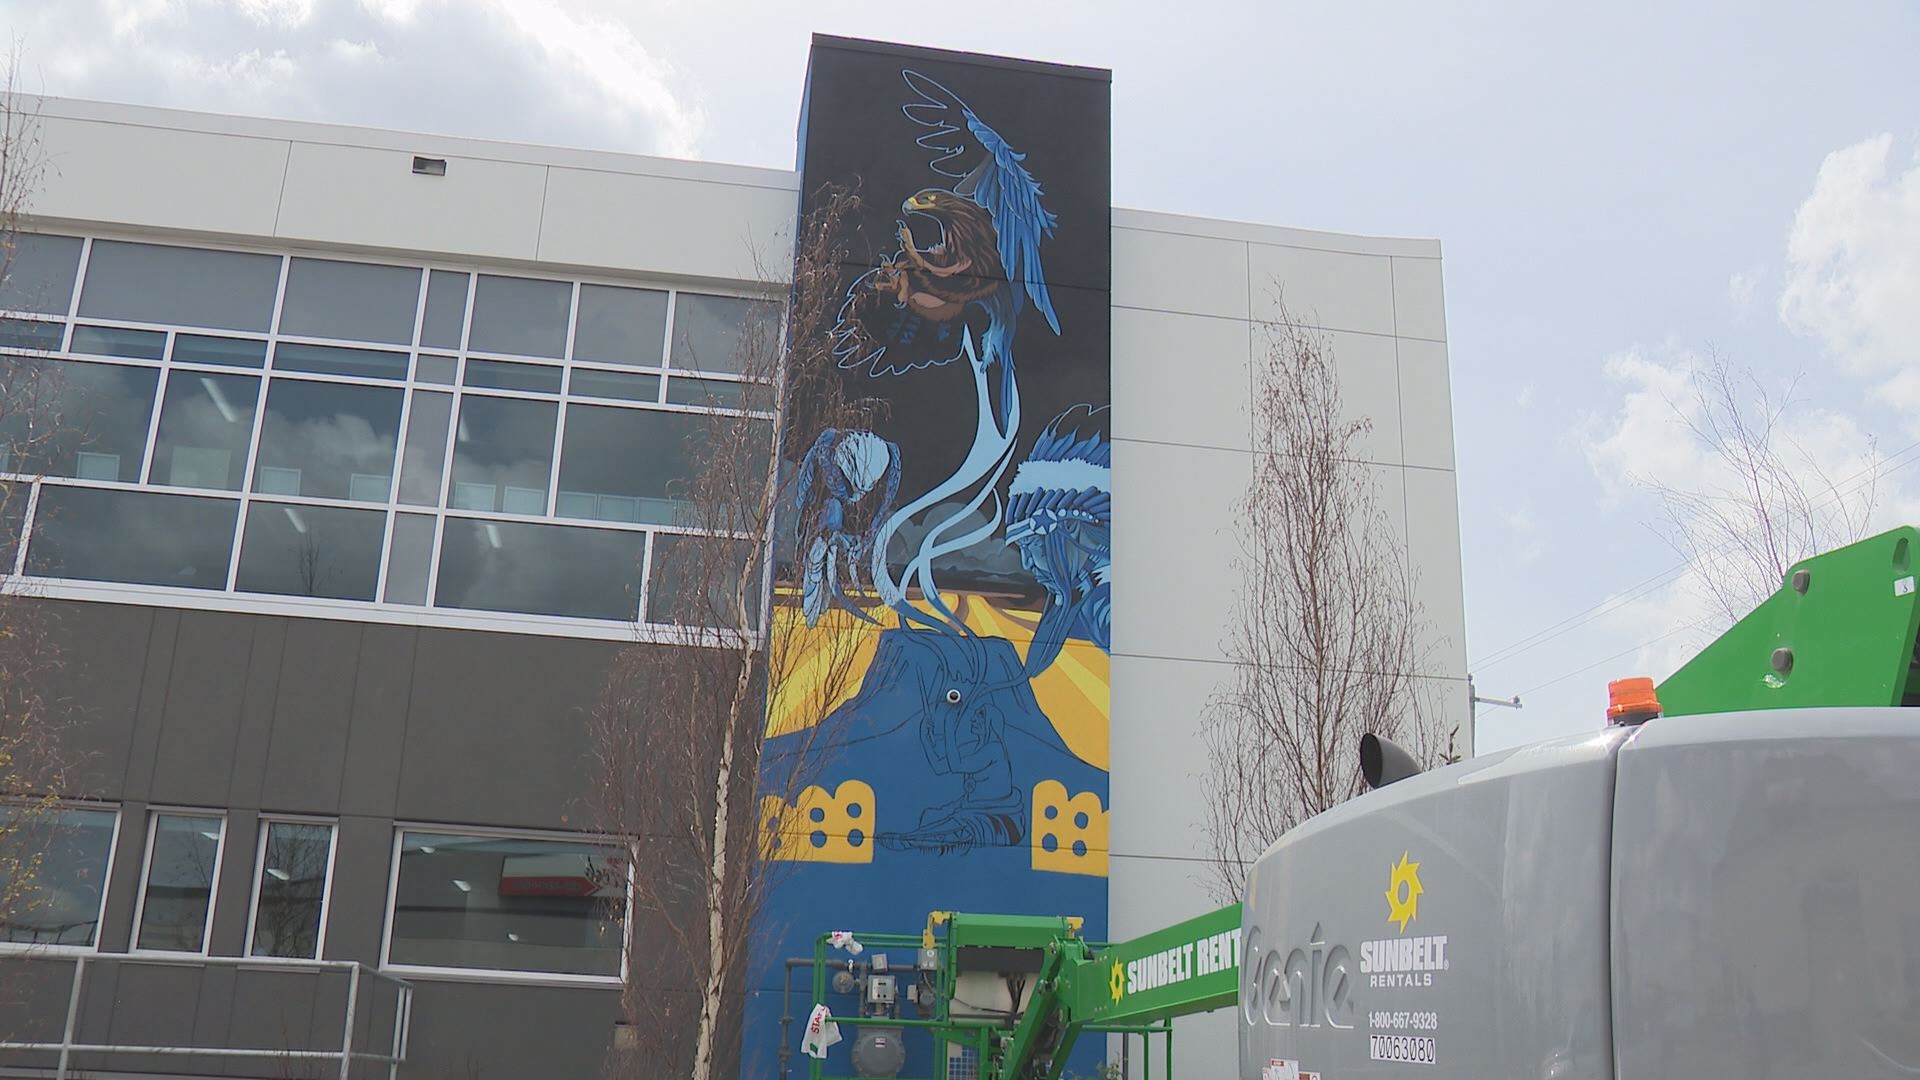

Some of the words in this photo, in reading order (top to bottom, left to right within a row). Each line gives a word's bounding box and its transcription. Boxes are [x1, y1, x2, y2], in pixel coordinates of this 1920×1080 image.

[1127, 943, 1193, 995] SUNBELT
[1244, 921, 1354, 1030] Genie
[1370, 973, 1432, 988] RENTALS
[1368, 1011, 1438, 1030] 1-800-667-9328
[1371, 1035, 1435, 1063] 70063080
